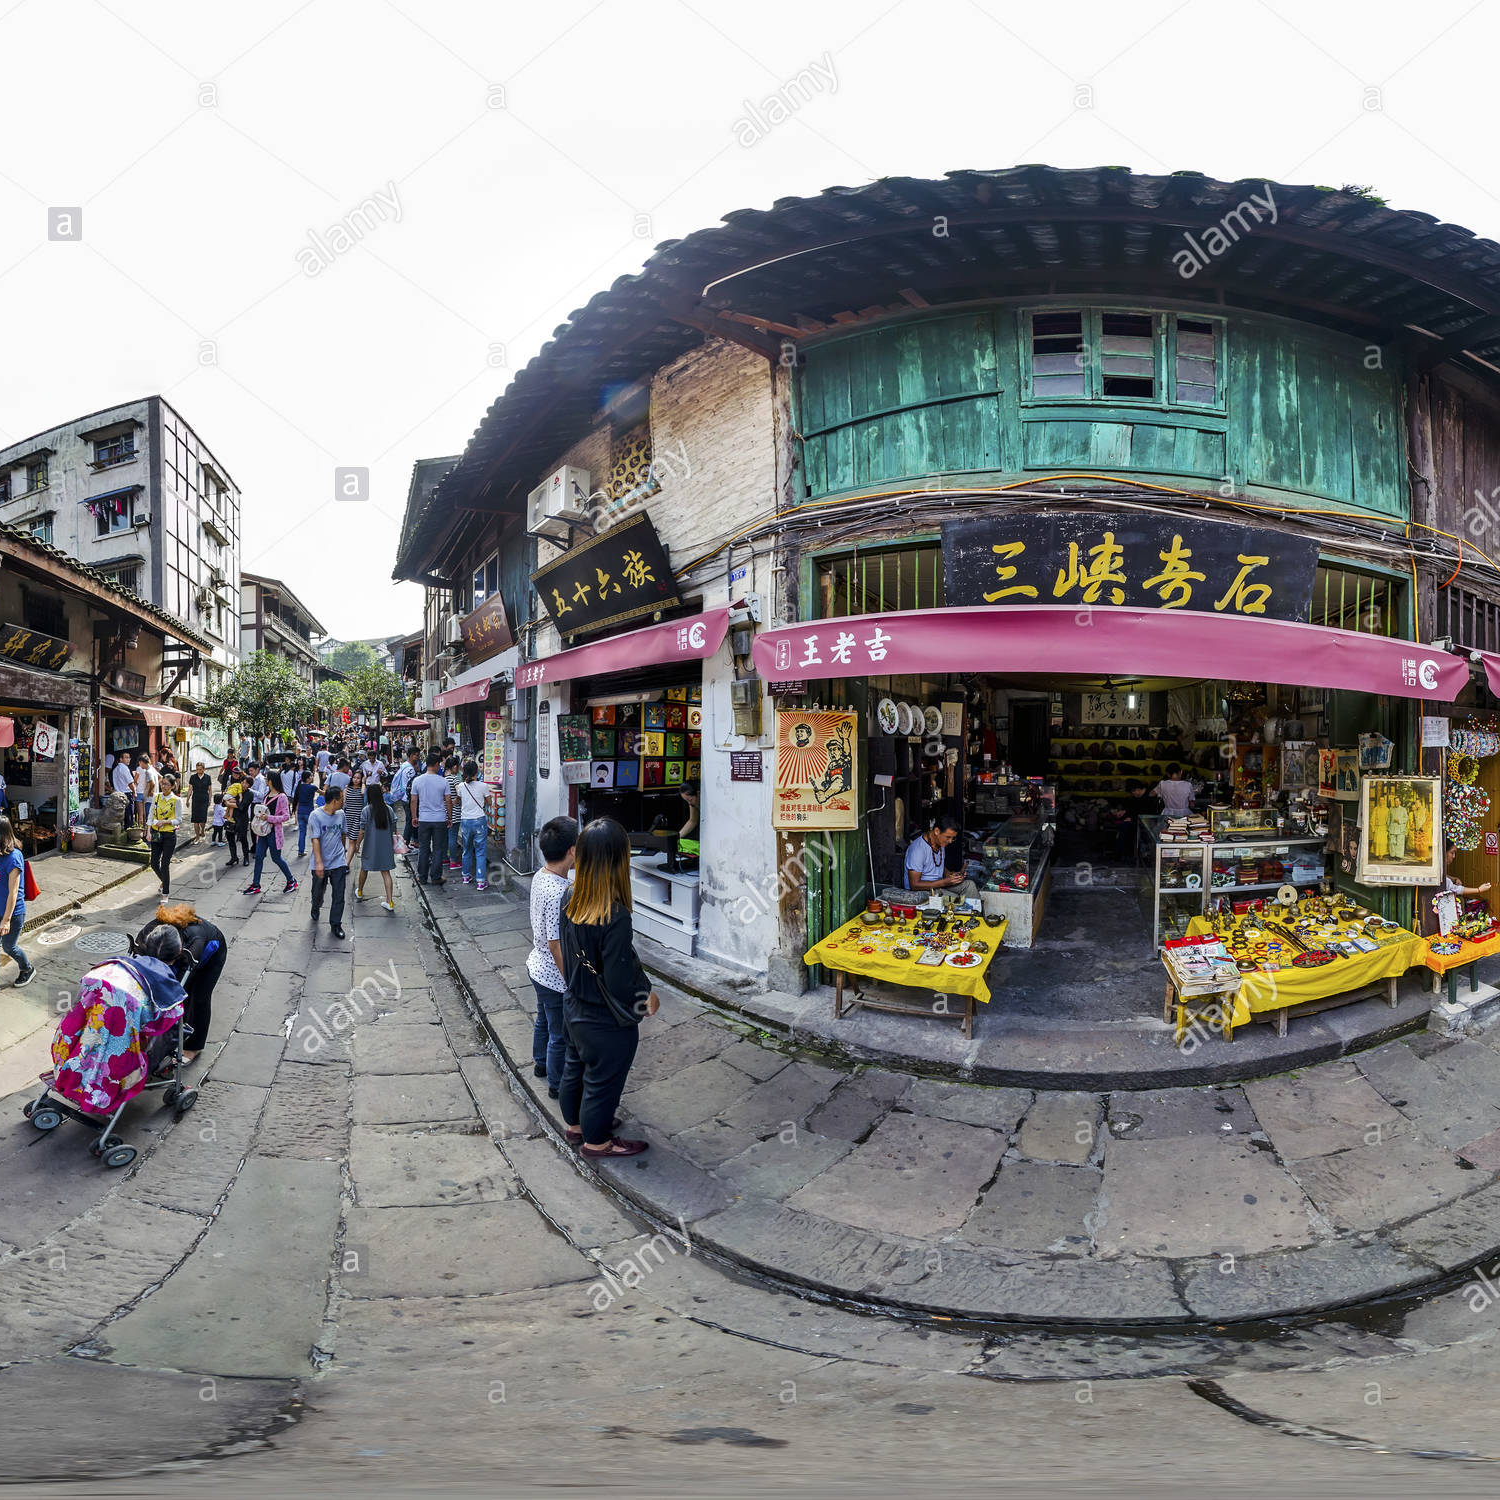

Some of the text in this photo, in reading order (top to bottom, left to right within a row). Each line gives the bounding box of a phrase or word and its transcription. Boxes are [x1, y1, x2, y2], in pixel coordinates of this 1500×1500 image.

[551, 549, 657, 618] 五十六族
[798, 628, 891, 668] 王老吉
